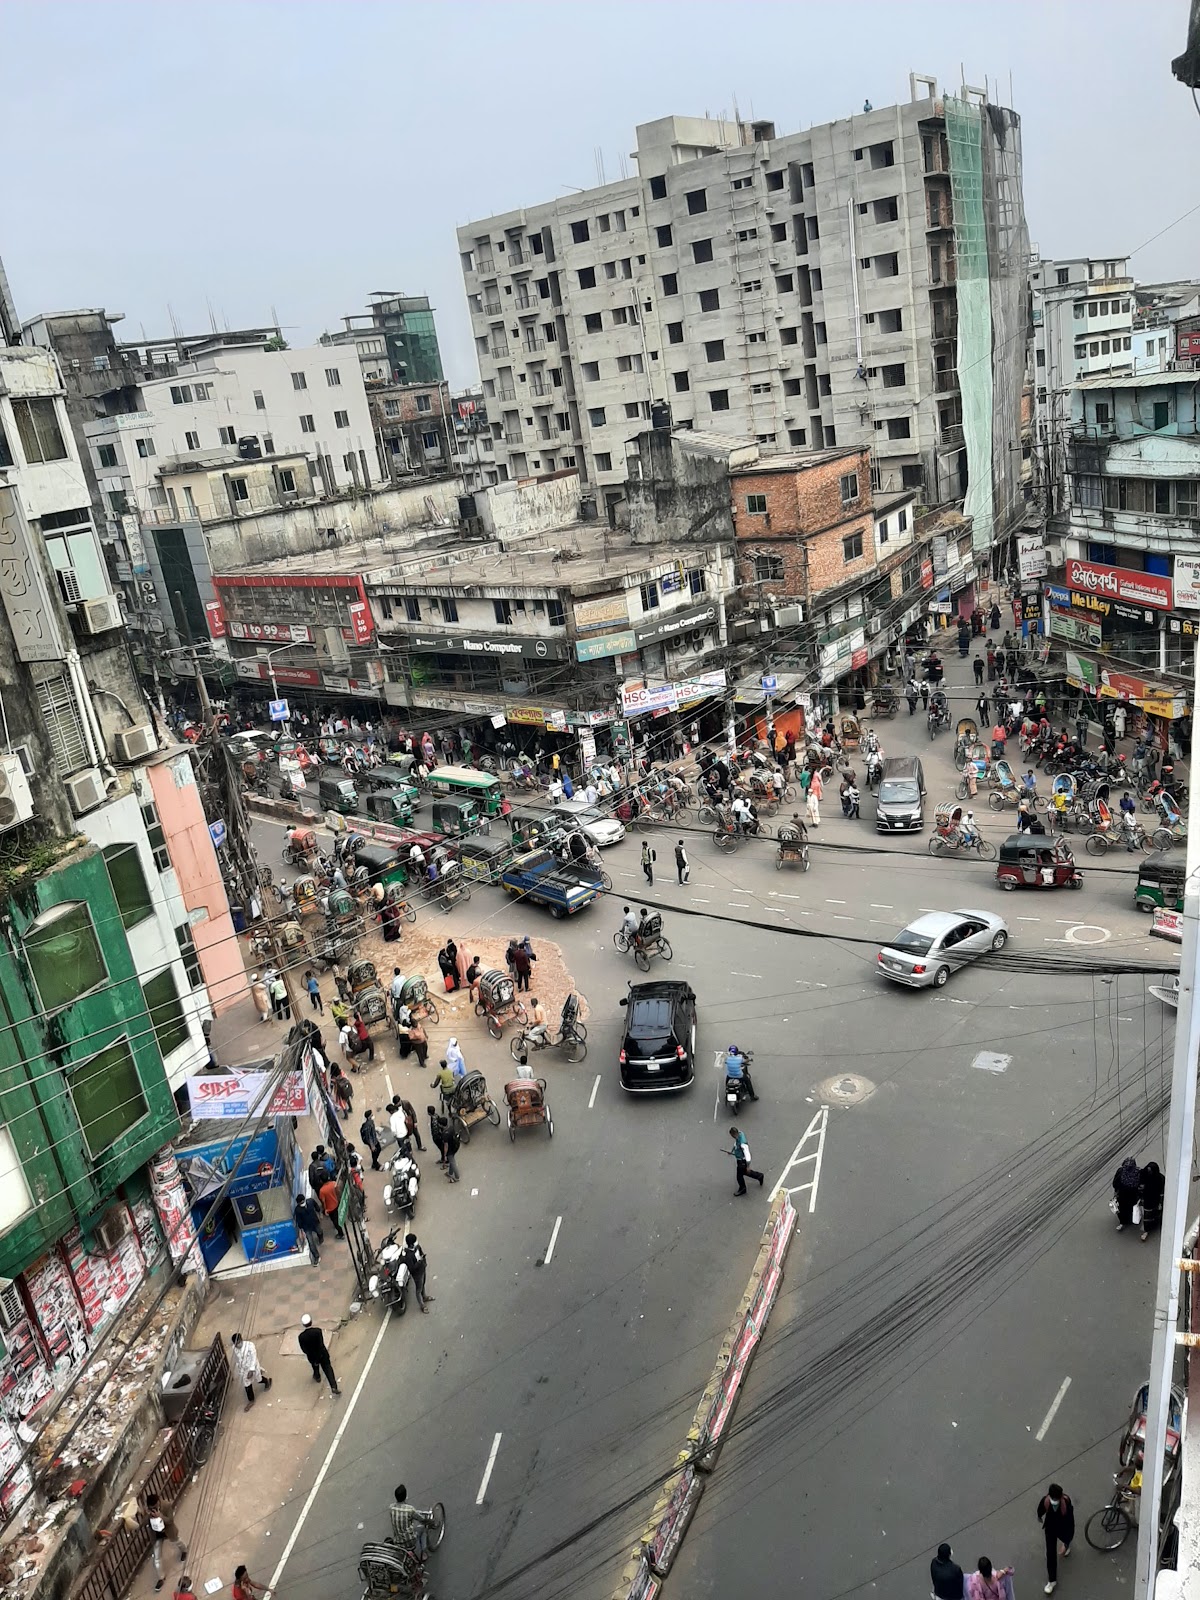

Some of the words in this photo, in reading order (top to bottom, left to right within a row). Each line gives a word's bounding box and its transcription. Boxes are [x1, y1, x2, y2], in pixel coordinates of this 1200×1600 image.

[1021, 543, 1044, 555] Index
[1051, 592, 1069, 601] pepsi
[1071, 592, 1086, 607] Me
[1086, 595, 1110, 616] Likey
[357, 618, 364, 626] to
[664, 622, 680, 632] Nano
[679, 612, 707, 627] Computer
[243, 625, 248, 633] 1
[250, 624, 262, 634] to
[263, 625, 278, 635] 99
[358, 625, 367, 634] 99
[463, 640, 483, 651] Nano
[484, 641, 522, 655] Computer
[624, 690, 647, 704] HSC
[676, 685, 699, 698] HSC
